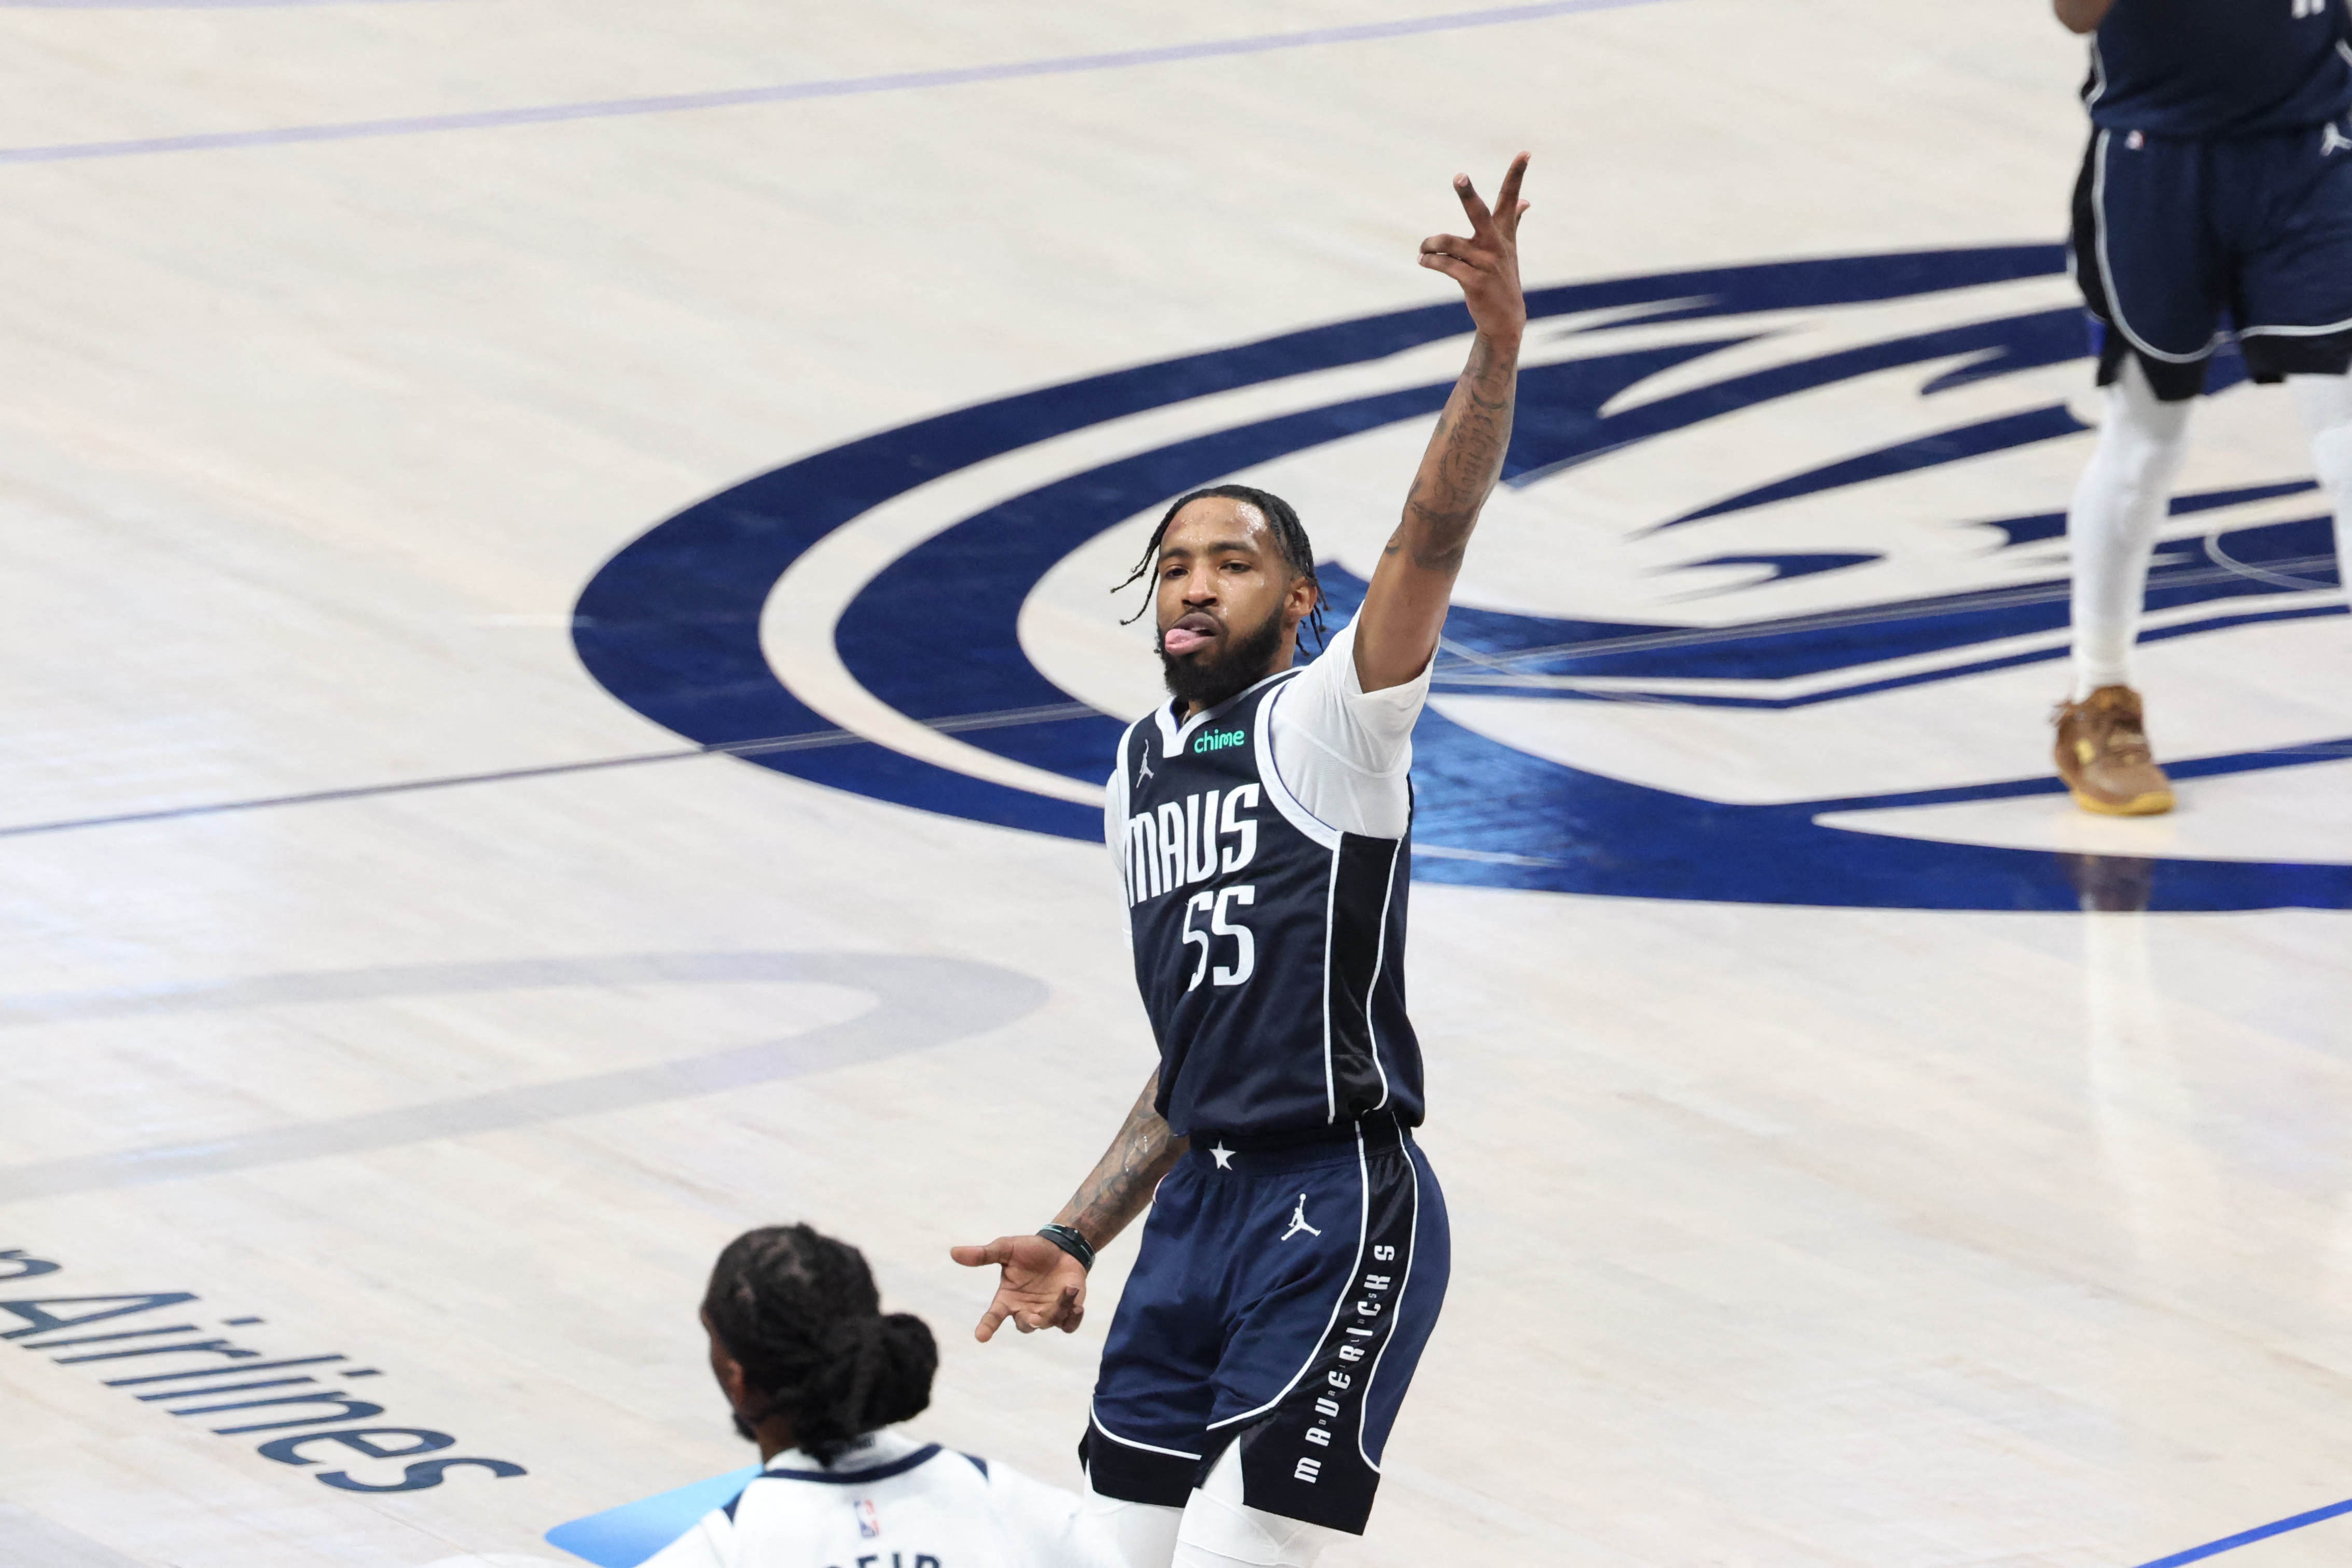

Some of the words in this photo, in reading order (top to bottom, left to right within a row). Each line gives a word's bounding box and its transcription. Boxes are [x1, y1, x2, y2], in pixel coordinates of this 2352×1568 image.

[1194, 729, 1245, 753] chime
[1183, 884, 1255, 992] 55
[0, 1292, 527, 1493] Airlines
[1294, 1245, 1394, 1483] MAVERICKS
